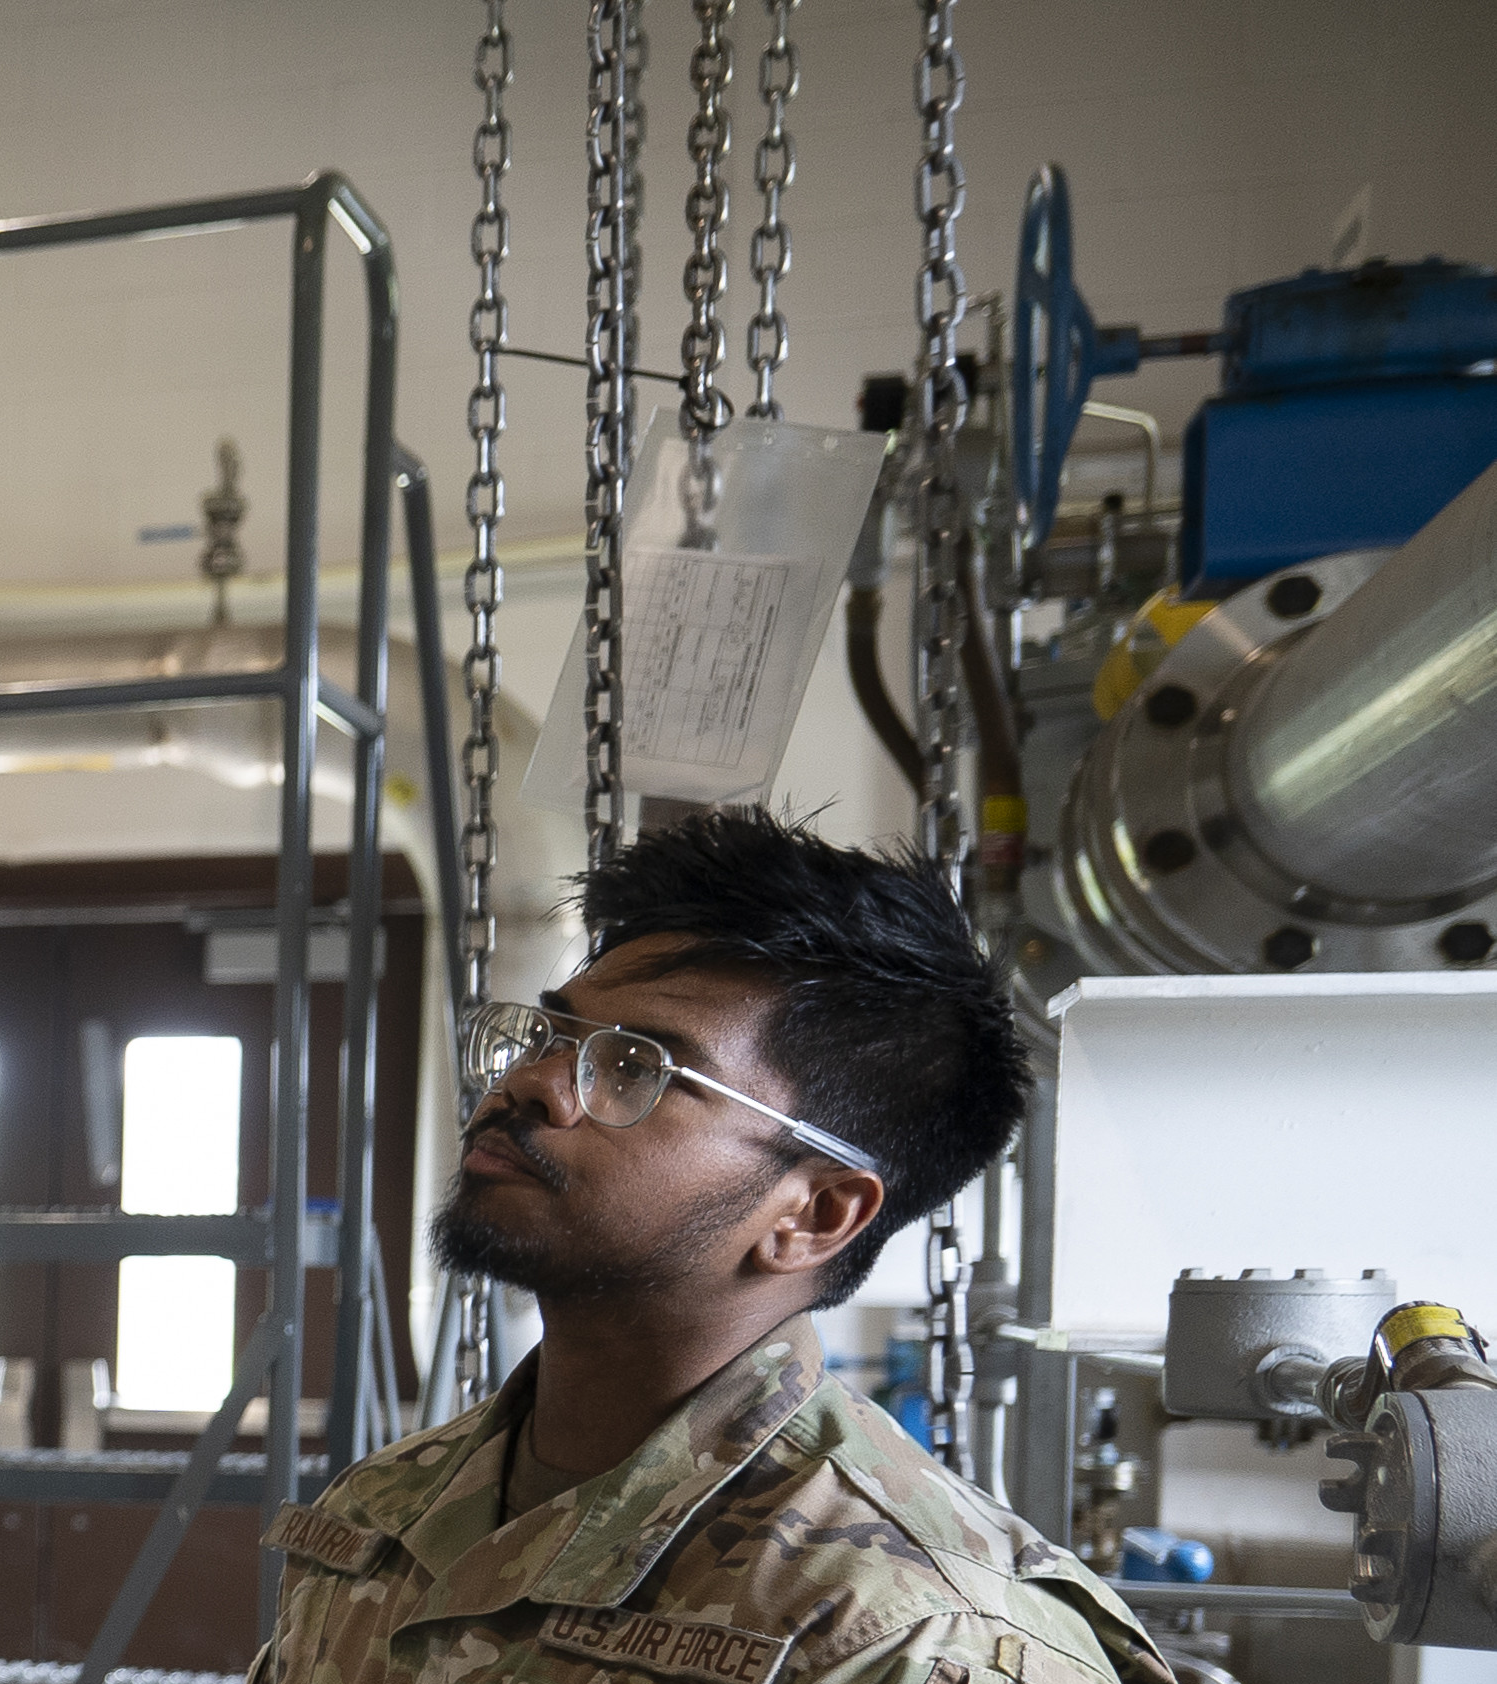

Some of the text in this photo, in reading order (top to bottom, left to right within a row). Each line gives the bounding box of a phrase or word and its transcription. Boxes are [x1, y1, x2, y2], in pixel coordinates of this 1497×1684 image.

[552, 1605, 771, 1684] U.S. AIR FORCE
